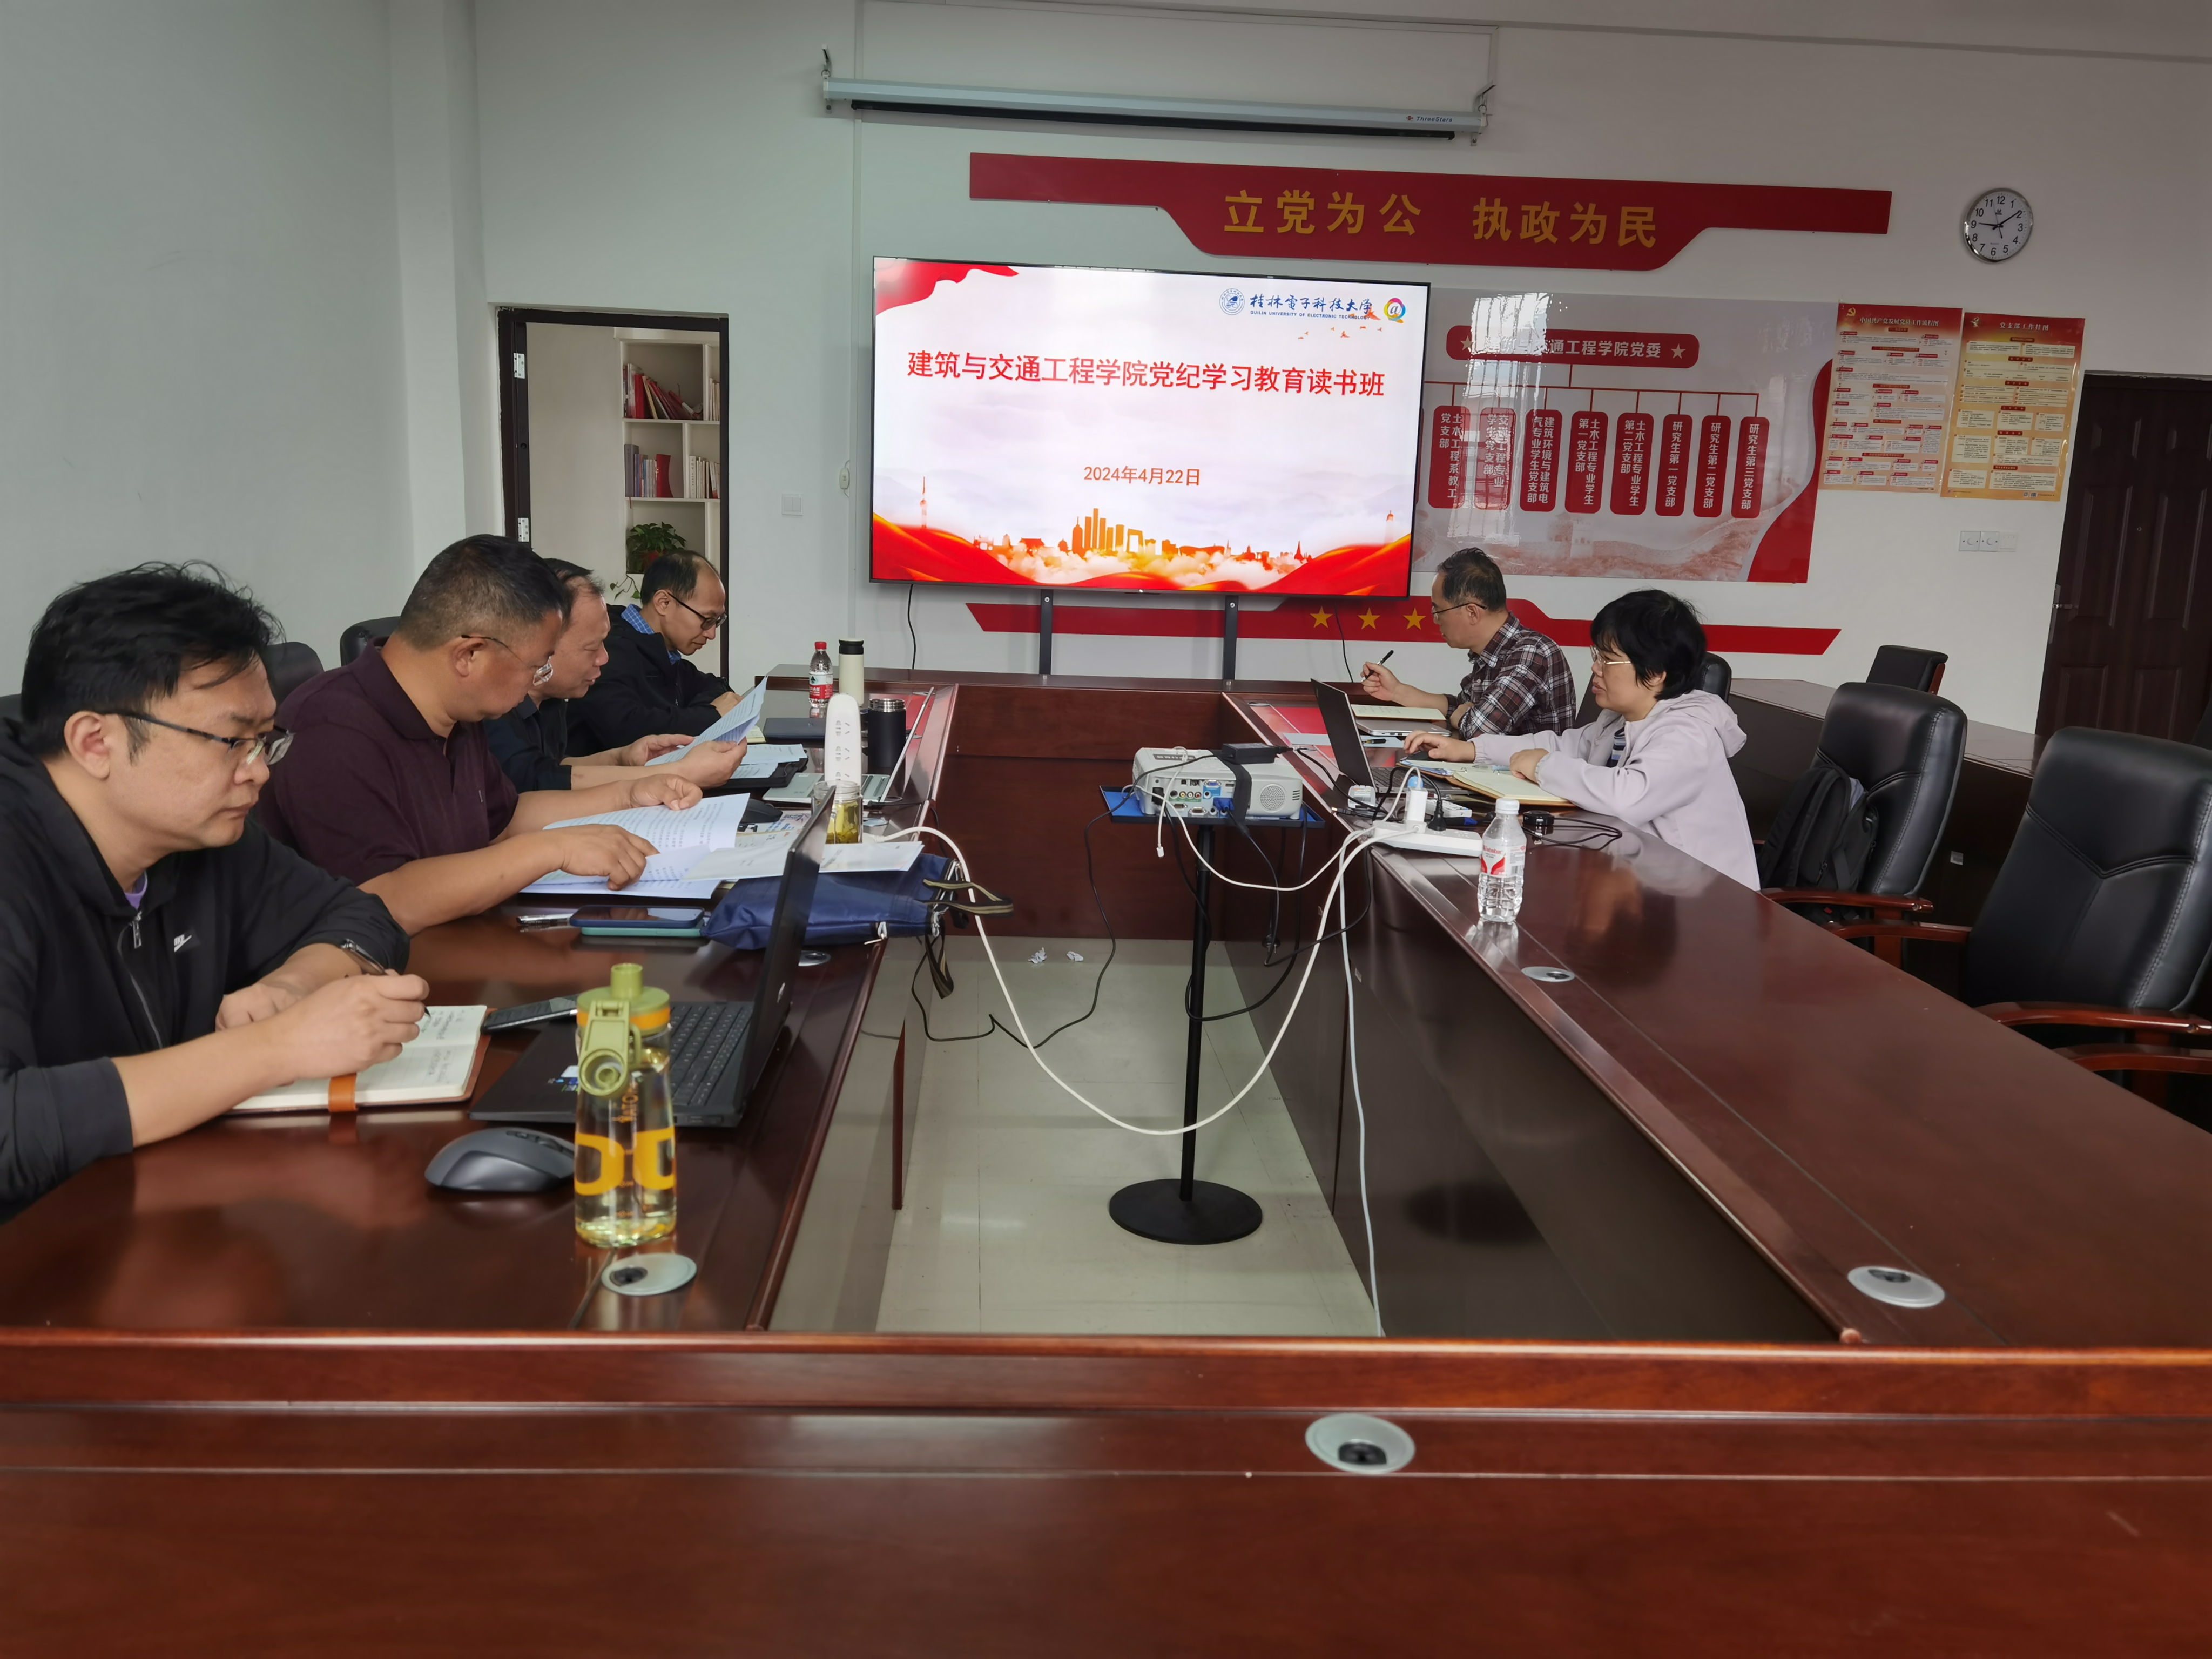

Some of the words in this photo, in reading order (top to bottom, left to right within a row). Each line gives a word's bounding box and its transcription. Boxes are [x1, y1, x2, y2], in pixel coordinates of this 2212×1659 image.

[1985, 199, 1993, 207] 11
[1997, 196, 2005, 204] 12
[1224, 190, 1421, 235] 立党为公
[1472, 197, 1657, 248] 执政为民
[1971, 220, 1977, 228] 9
[1975, 208, 1984, 217] 10
[2016, 210, 2022, 218] 2
[1972, 233, 1978, 242] 8
[2018, 223, 2023, 232] 3
[1980, 244, 1985, 252] 7
[1991, 247, 1996, 256] 6
[2003, 245, 2008, 253] 5
[2013, 236, 2018, 244] 4
[1485, 336, 1661, 359] 通工程学院党委
[907, 349, 1385, 397] 建筑与交通工程学院党纪学习教育读书班
[1439, 413, 1451, 449] 党支部
[1575, 418, 1589, 473] 第一党支部
[1621, 420, 1635, 474] 第二党支部
[1527, 417, 1543, 503] 气专业学生党支部
[1539, 417, 1555, 503] 建筑环境与建筑电
[1584, 419, 1600, 505] 土木工程专业学生
[1629, 421, 1646, 507] 土木工程专业学生
[1665, 421, 1683, 508] 研究生第一党支部
[1703, 423, 1721, 509] 研究生第二党支部
[1741, 424, 1759, 510] 研究生第三党支部
[1083, 464, 1201, 486] 2024年4月22日
